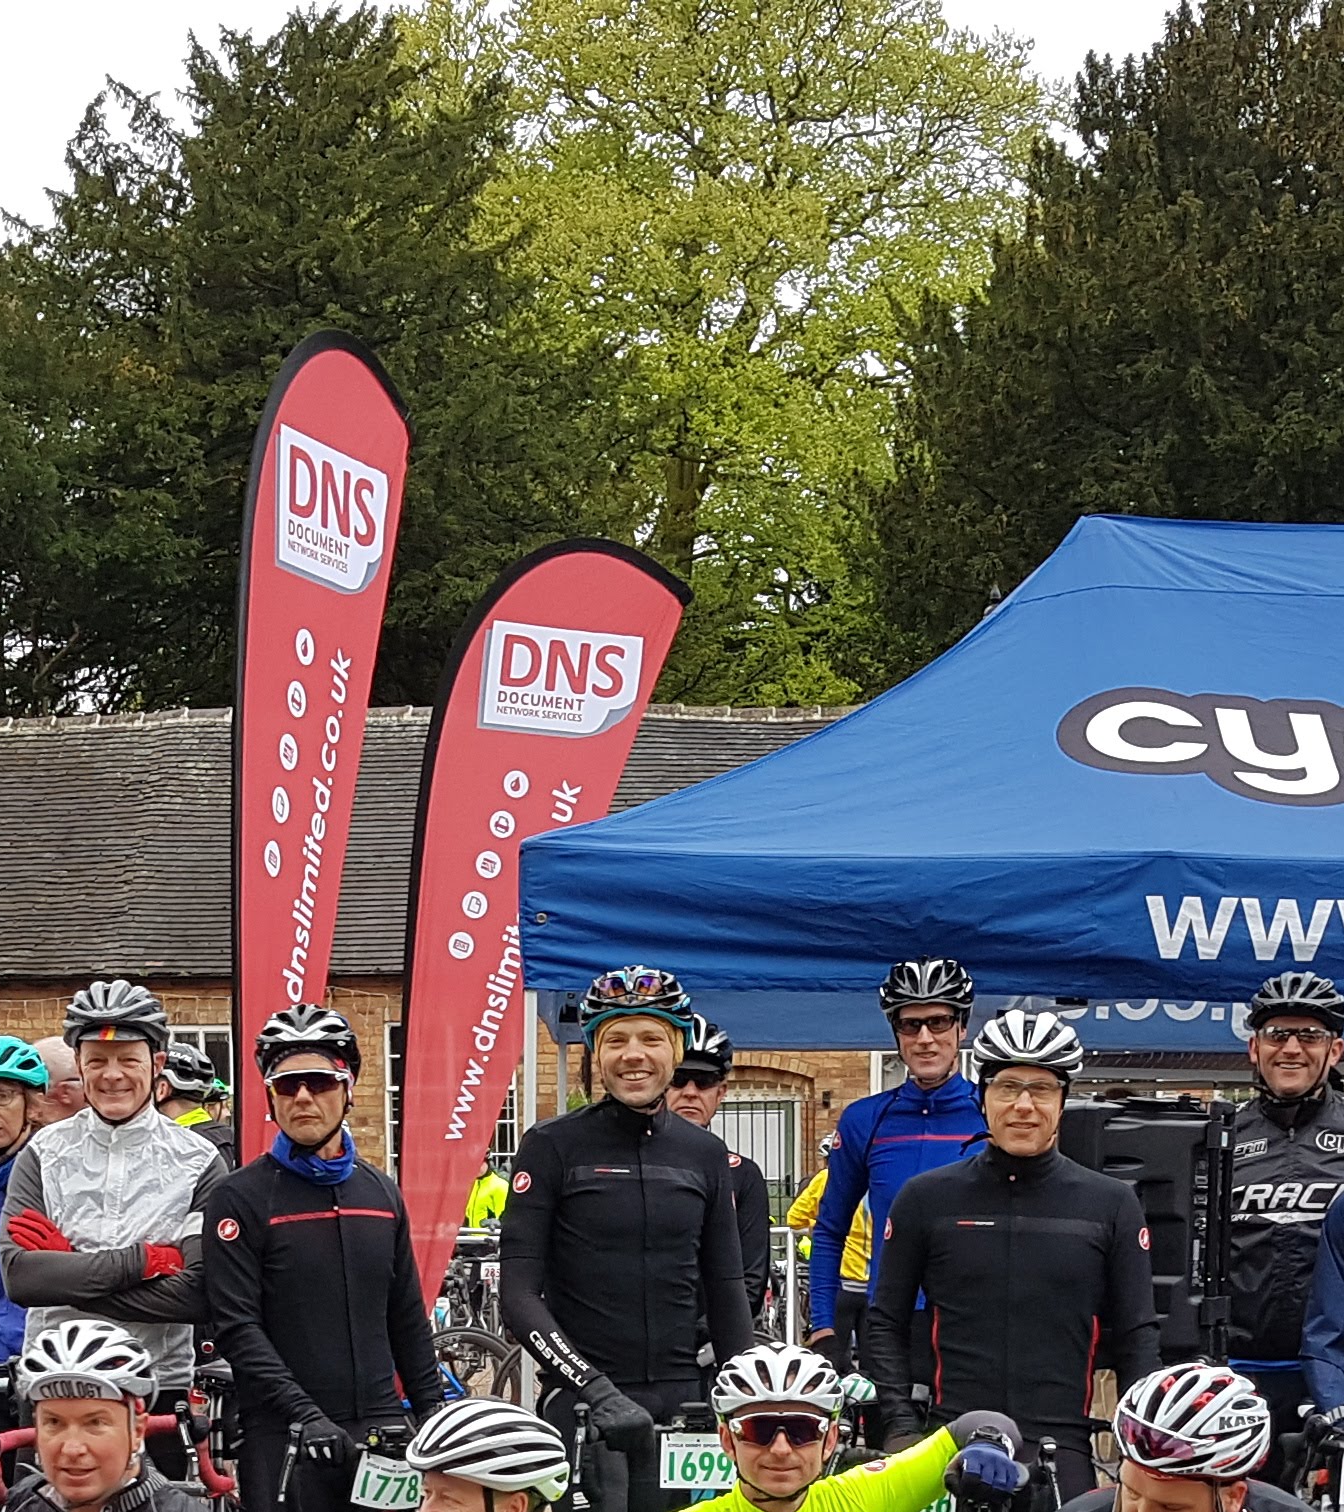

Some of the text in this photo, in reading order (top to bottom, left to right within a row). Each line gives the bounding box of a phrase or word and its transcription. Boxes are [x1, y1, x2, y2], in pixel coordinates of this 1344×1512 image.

[289, 444, 376, 547] DNS
[287, 518, 351, 560] DOCUMENT
[287, 539, 349, 575] NETWORK SERVICES
[498, 633, 627, 699] DNS
[496, 705, 583, 723] NETWORK SERVICES
[497, 691, 586, 712] DOCUMENT
[39, 1380, 102, 1399] CYCOLOGY
[667, 1451, 733, 1482] 1699
[359, 1470, 419, 1504] 1778
